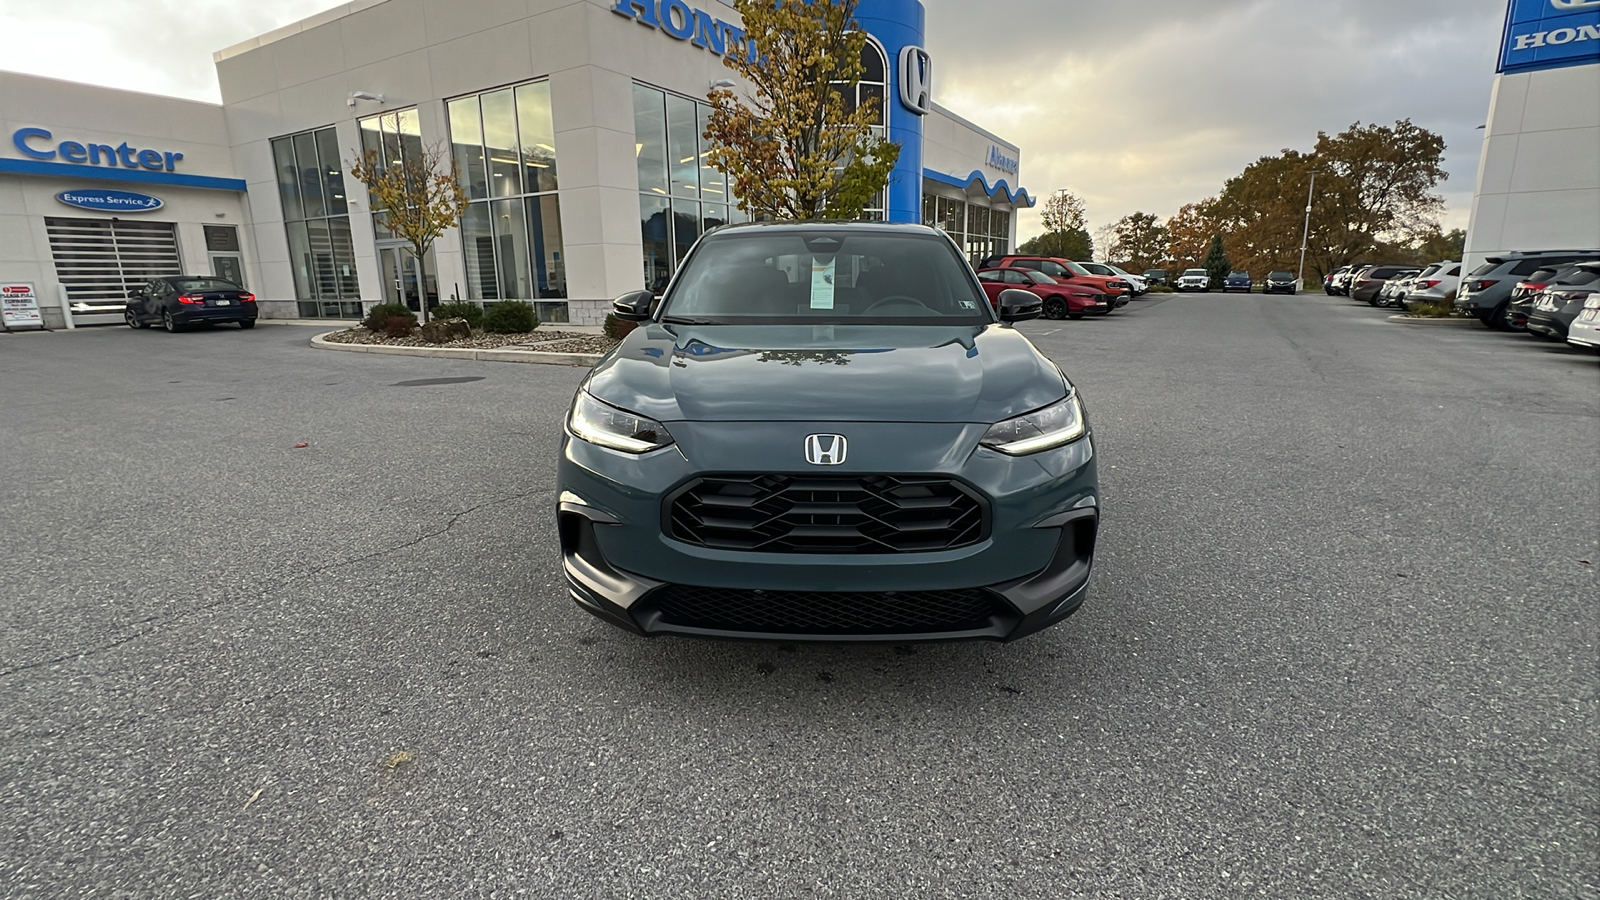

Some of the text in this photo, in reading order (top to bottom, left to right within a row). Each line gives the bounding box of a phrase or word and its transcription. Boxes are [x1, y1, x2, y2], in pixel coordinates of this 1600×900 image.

[12, 127, 184, 172] Center
[63, 193, 144, 205] Express Service
